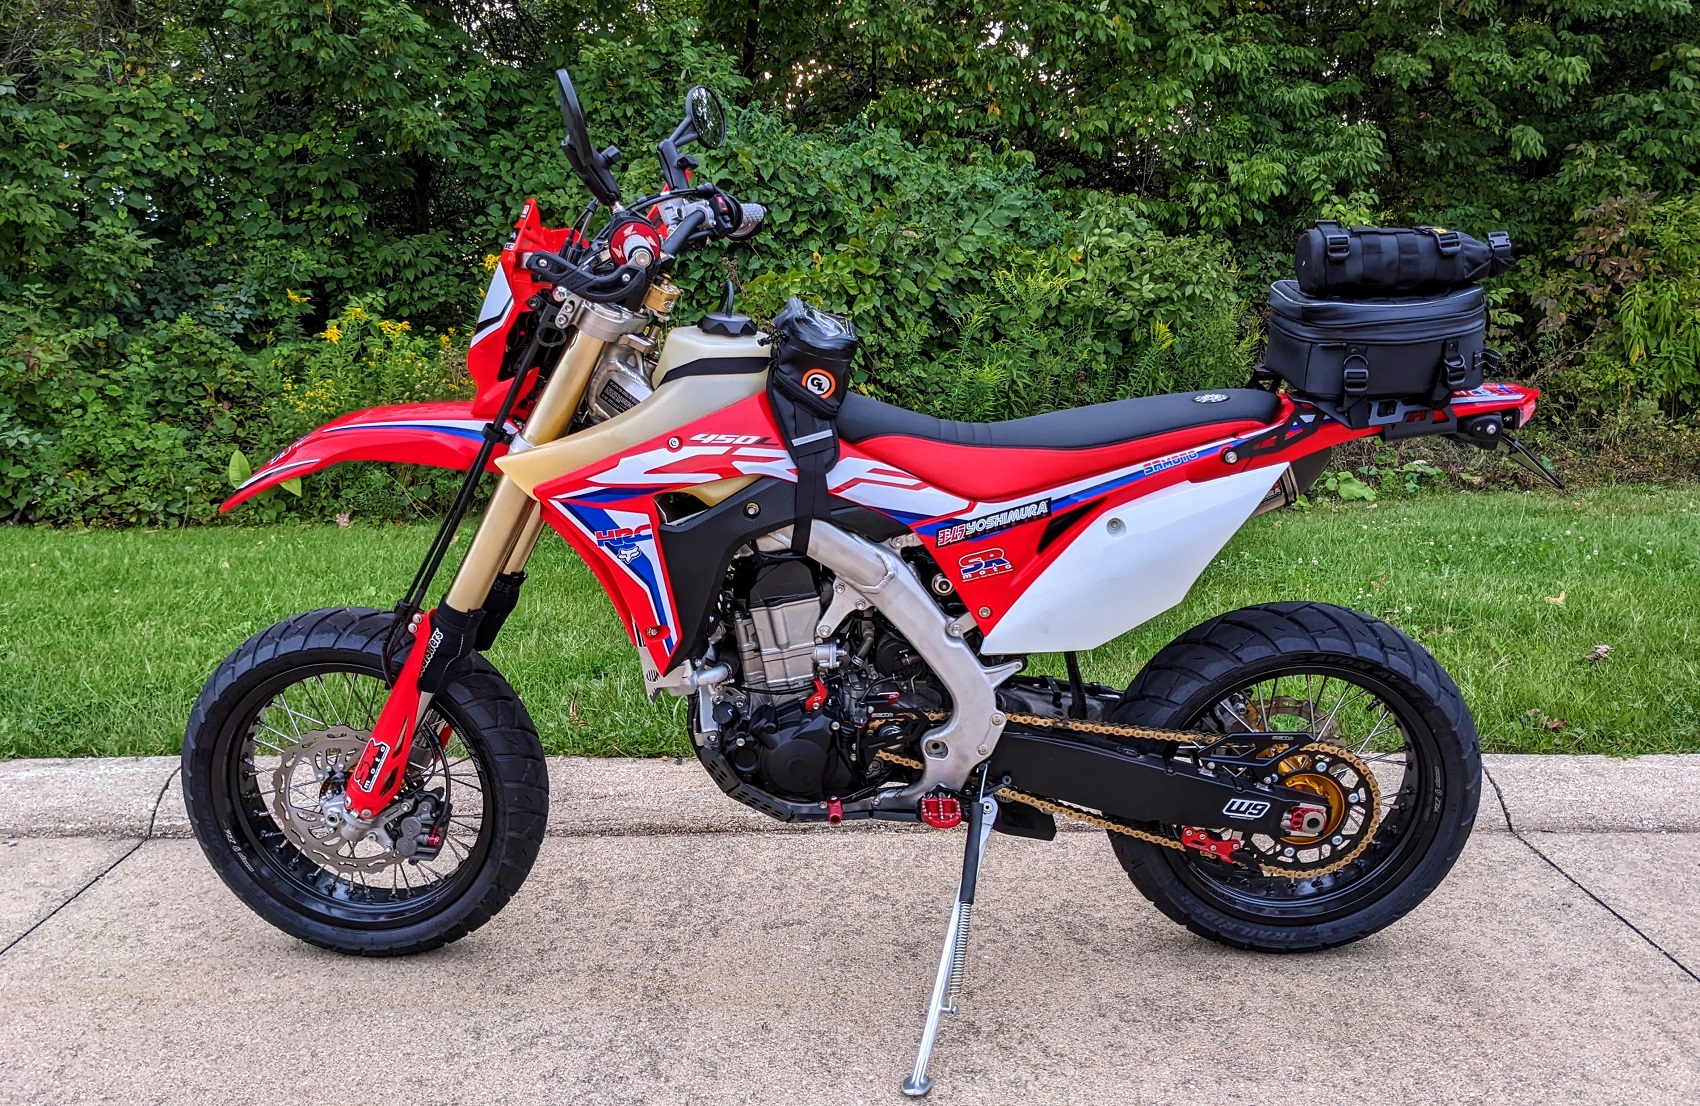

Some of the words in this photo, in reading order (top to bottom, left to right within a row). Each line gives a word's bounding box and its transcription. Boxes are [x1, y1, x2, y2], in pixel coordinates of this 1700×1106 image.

[690, 433, 779, 445] 450L
[966, 501, 1048, 536] YOSHIMURA
[595, 523, 653, 547] HRC
[959, 548, 1010, 575] SR
[963, 562, 1012, 579] moto
[355, 739, 381, 786] SR
[363, 745, 386, 789] moto
